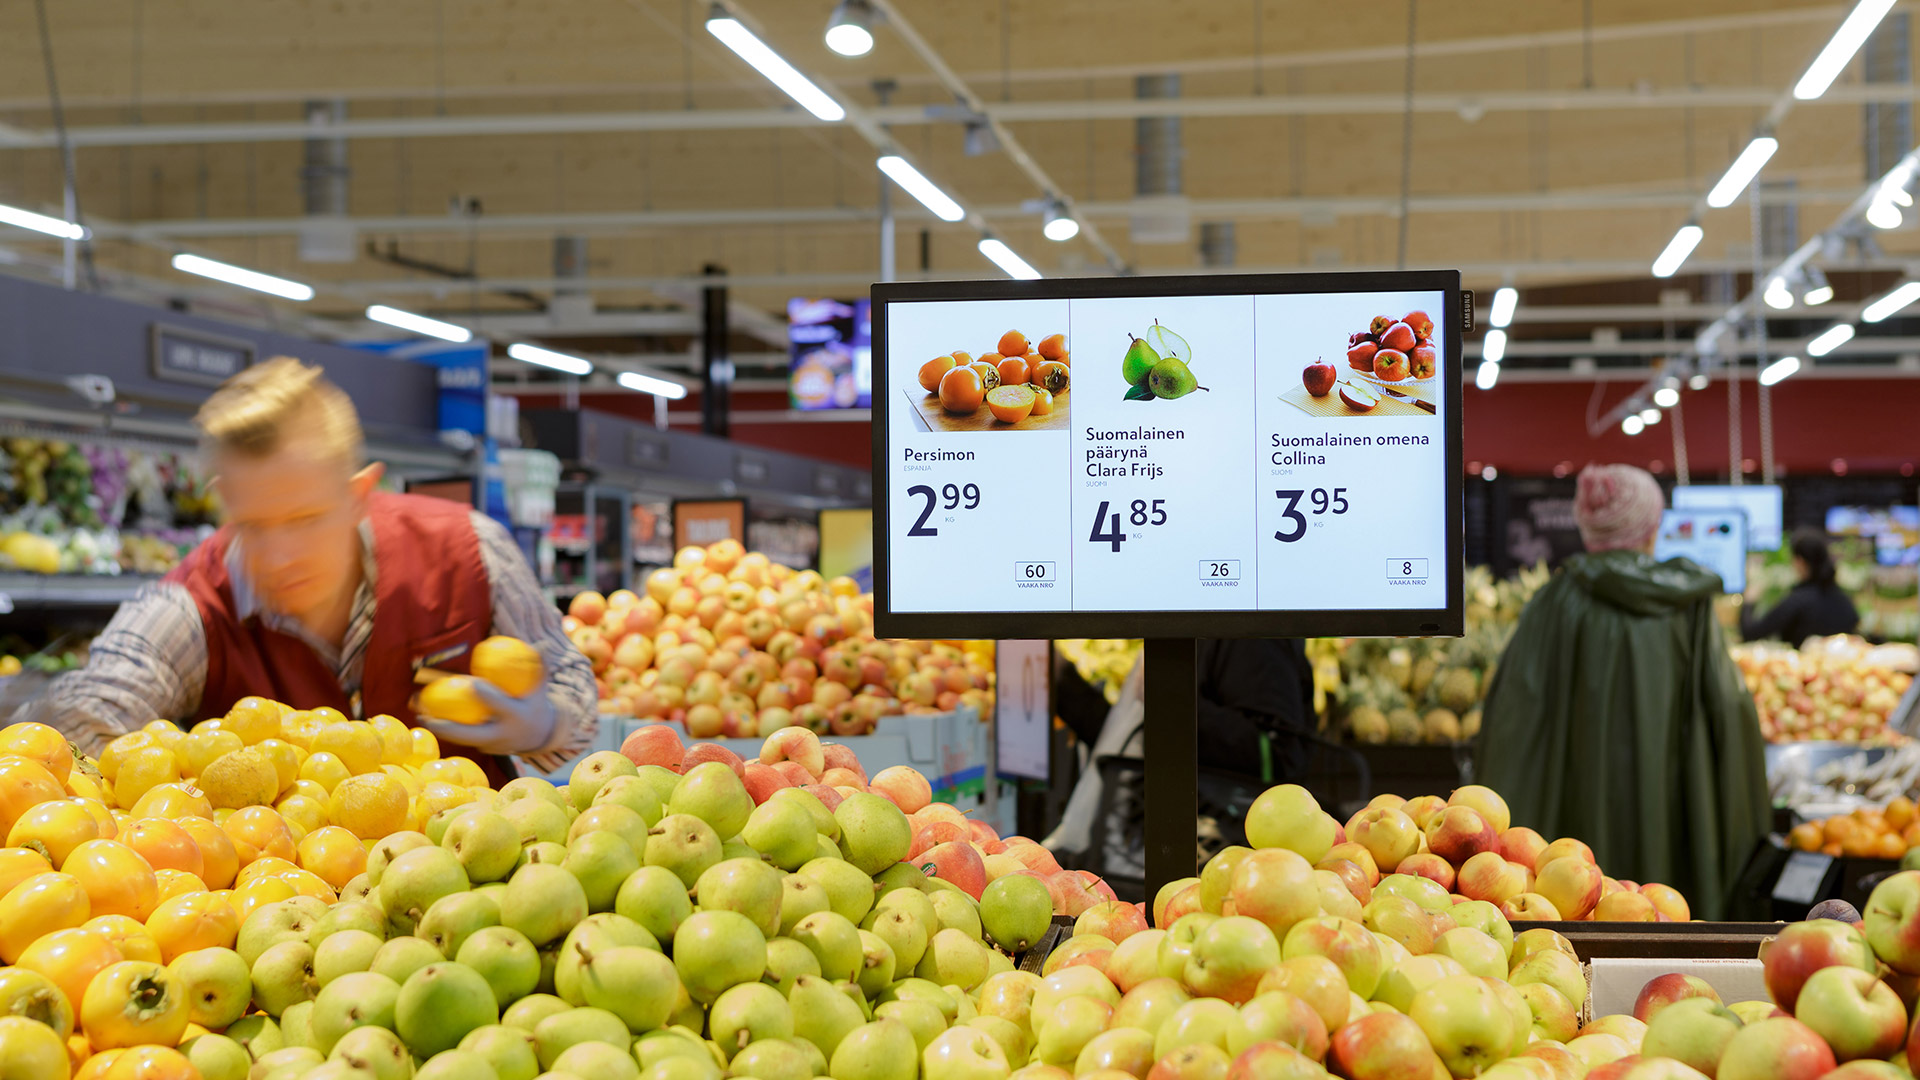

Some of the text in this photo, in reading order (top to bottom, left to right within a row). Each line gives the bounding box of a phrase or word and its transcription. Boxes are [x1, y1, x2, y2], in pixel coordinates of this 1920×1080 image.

[1086, 426, 1185, 441] Suomalainen
[1271, 431, 1429, 448] Suomalainen omena
[904, 447, 975, 462] Persimon
[1086, 445, 1148, 462] päärynä
[1271, 450, 1326, 466] Collina
[1086, 462, 1164, 480] Clara Frijs
[1271, 468, 1293, 476] SUOMI
[1086, 480, 1108, 488] SUOMI
[1132, 532, 1143, 540] KG
[1025, 564, 1046, 579] 60
[1211, 562, 1229, 577] 26
[1402, 561, 1412, 576] 8
